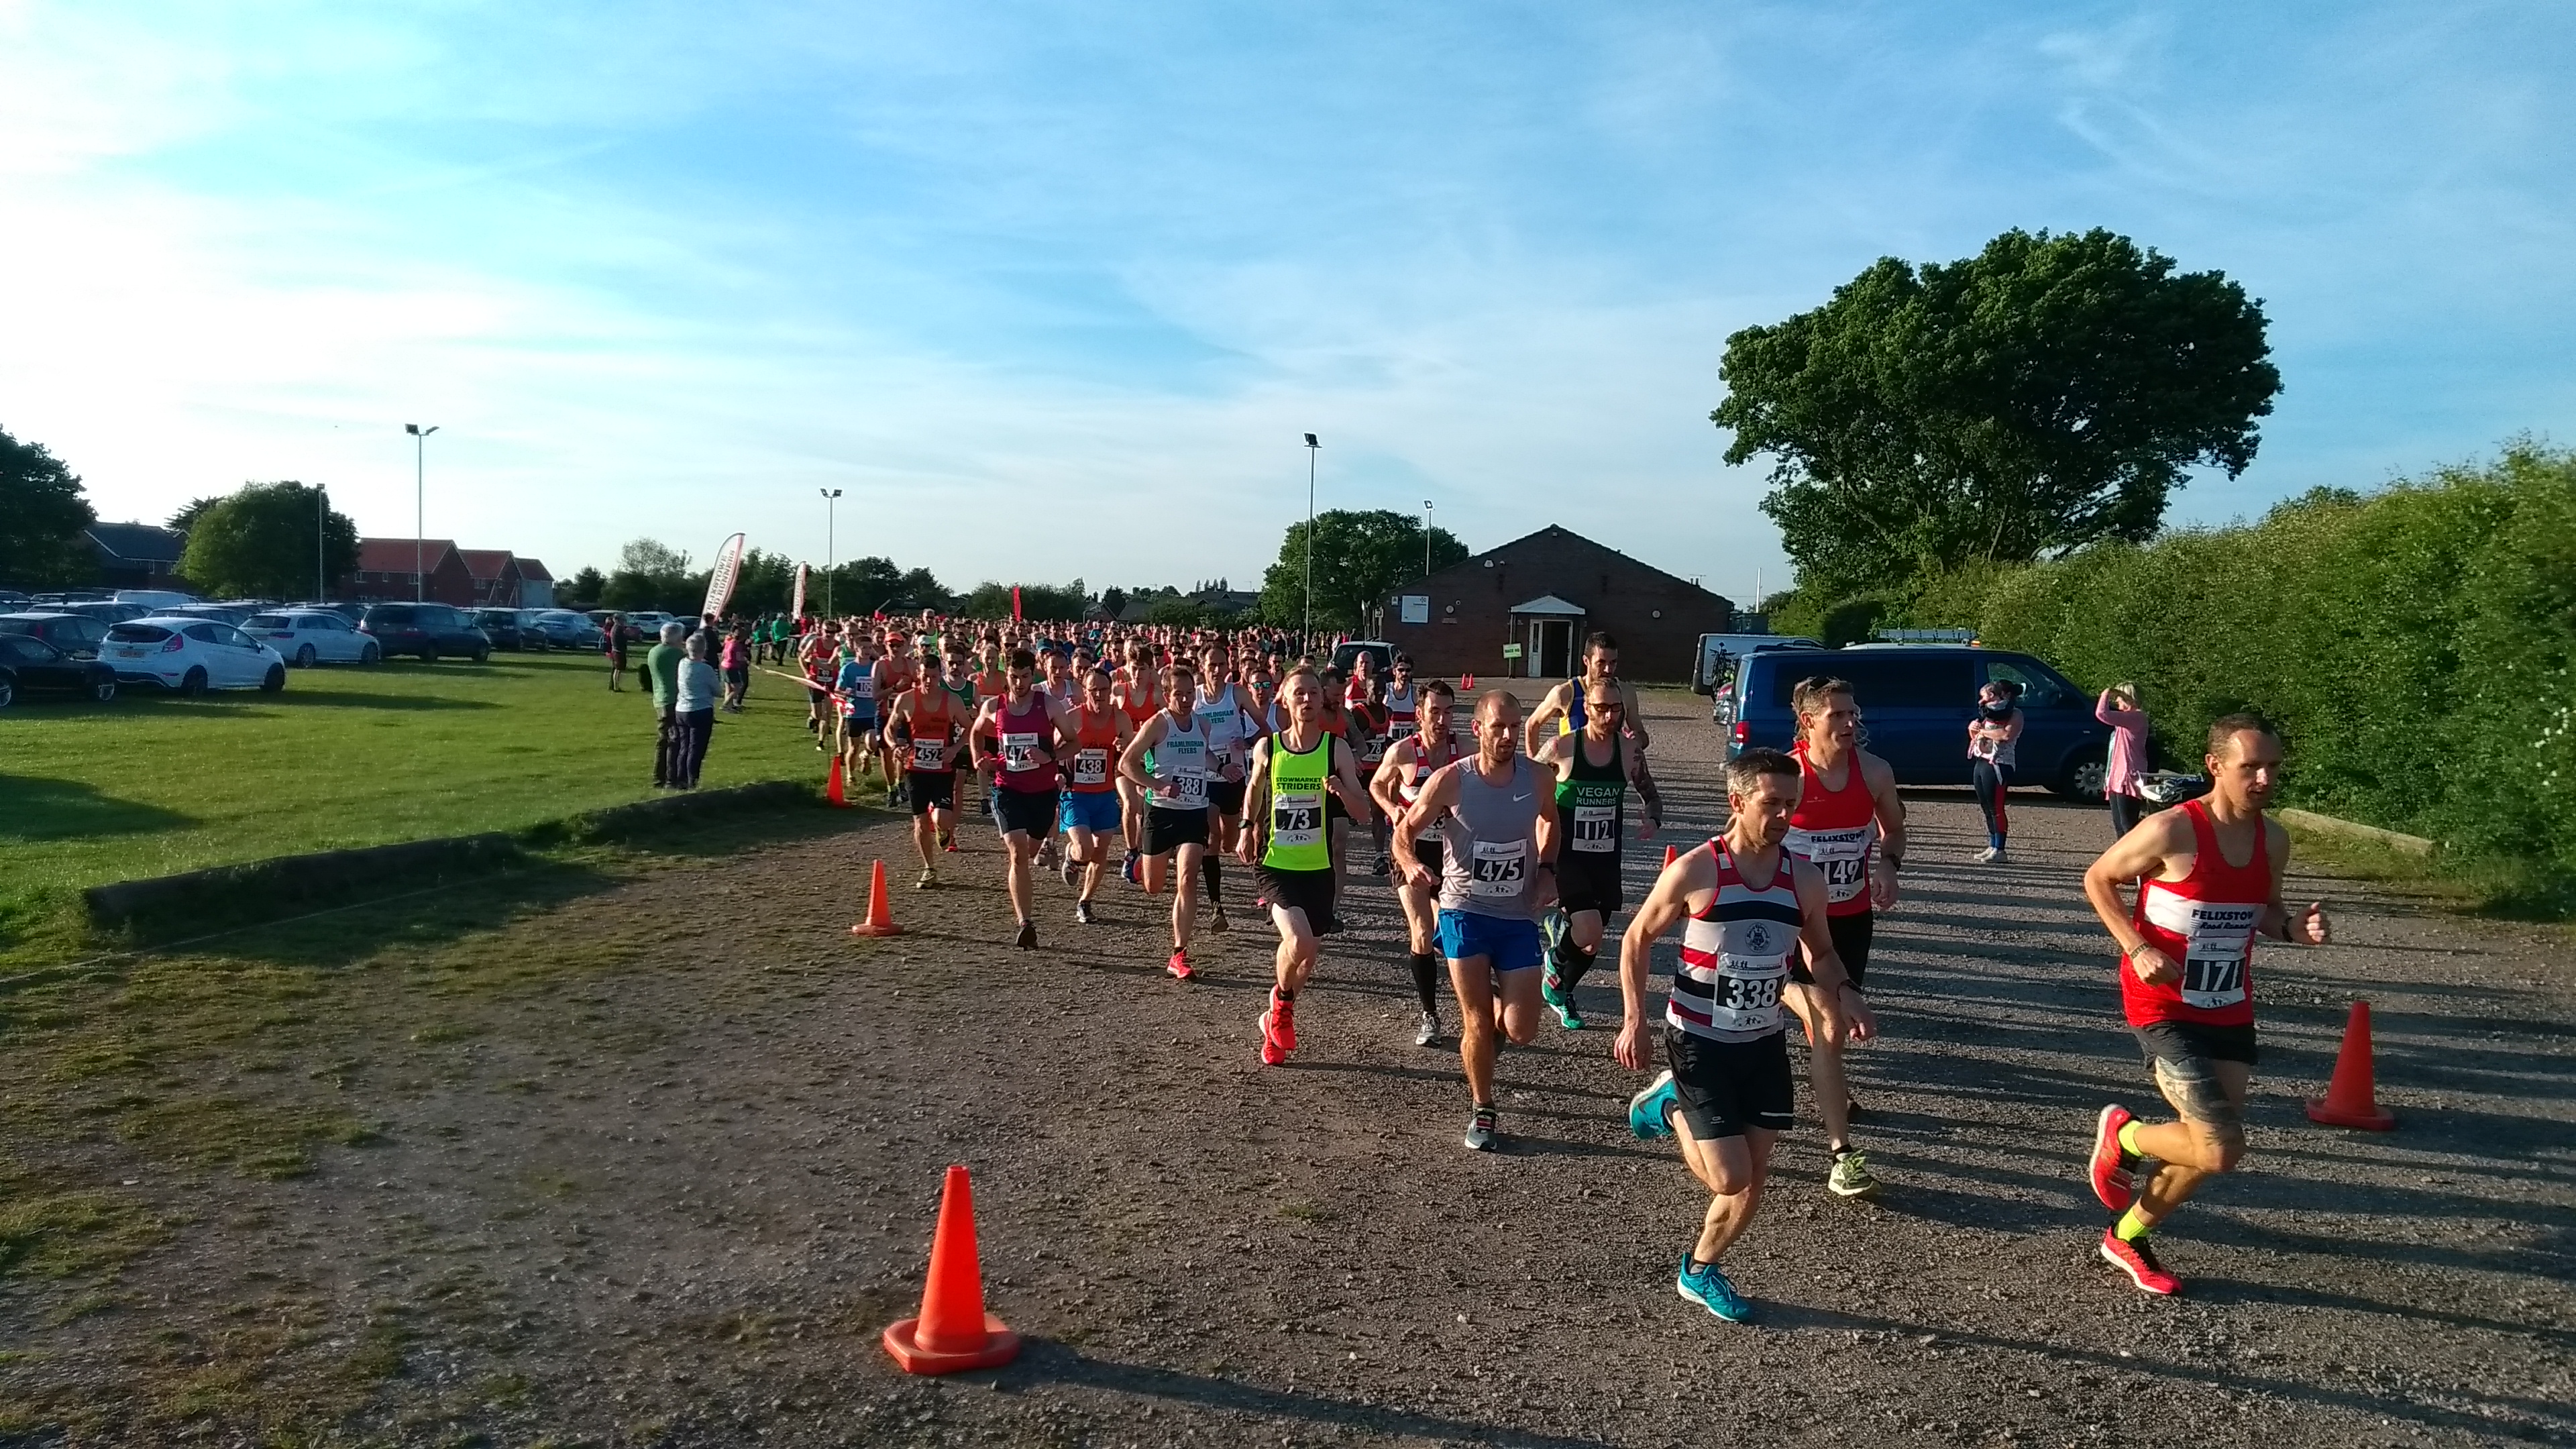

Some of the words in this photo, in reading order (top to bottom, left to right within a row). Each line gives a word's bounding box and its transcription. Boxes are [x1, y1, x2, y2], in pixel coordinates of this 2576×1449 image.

[706, 555, 727, 613] ELIXSTOWE
[1008, 745, 1025, 761] 47
[1167, 740, 1205, 748] FRAMLINGHAM
[1370, 743, 1382, 755] 78
[918, 749, 939, 761] 452
[1079, 759, 1102, 773] 438
[1177, 777, 1200, 795] 388
[1576, 786, 1620, 797] VEGAN
[1576, 796, 1617, 805] RUNNERS
[1287, 809, 1310, 830] 73
[1585, 820, 1609, 840] 112
[1481, 859, 1520, 881] 475
[1824, 861, 1860, 885] 149
[2200, 961, 2240, 991] 171
[1726, 978, 1778, 1010] 338
